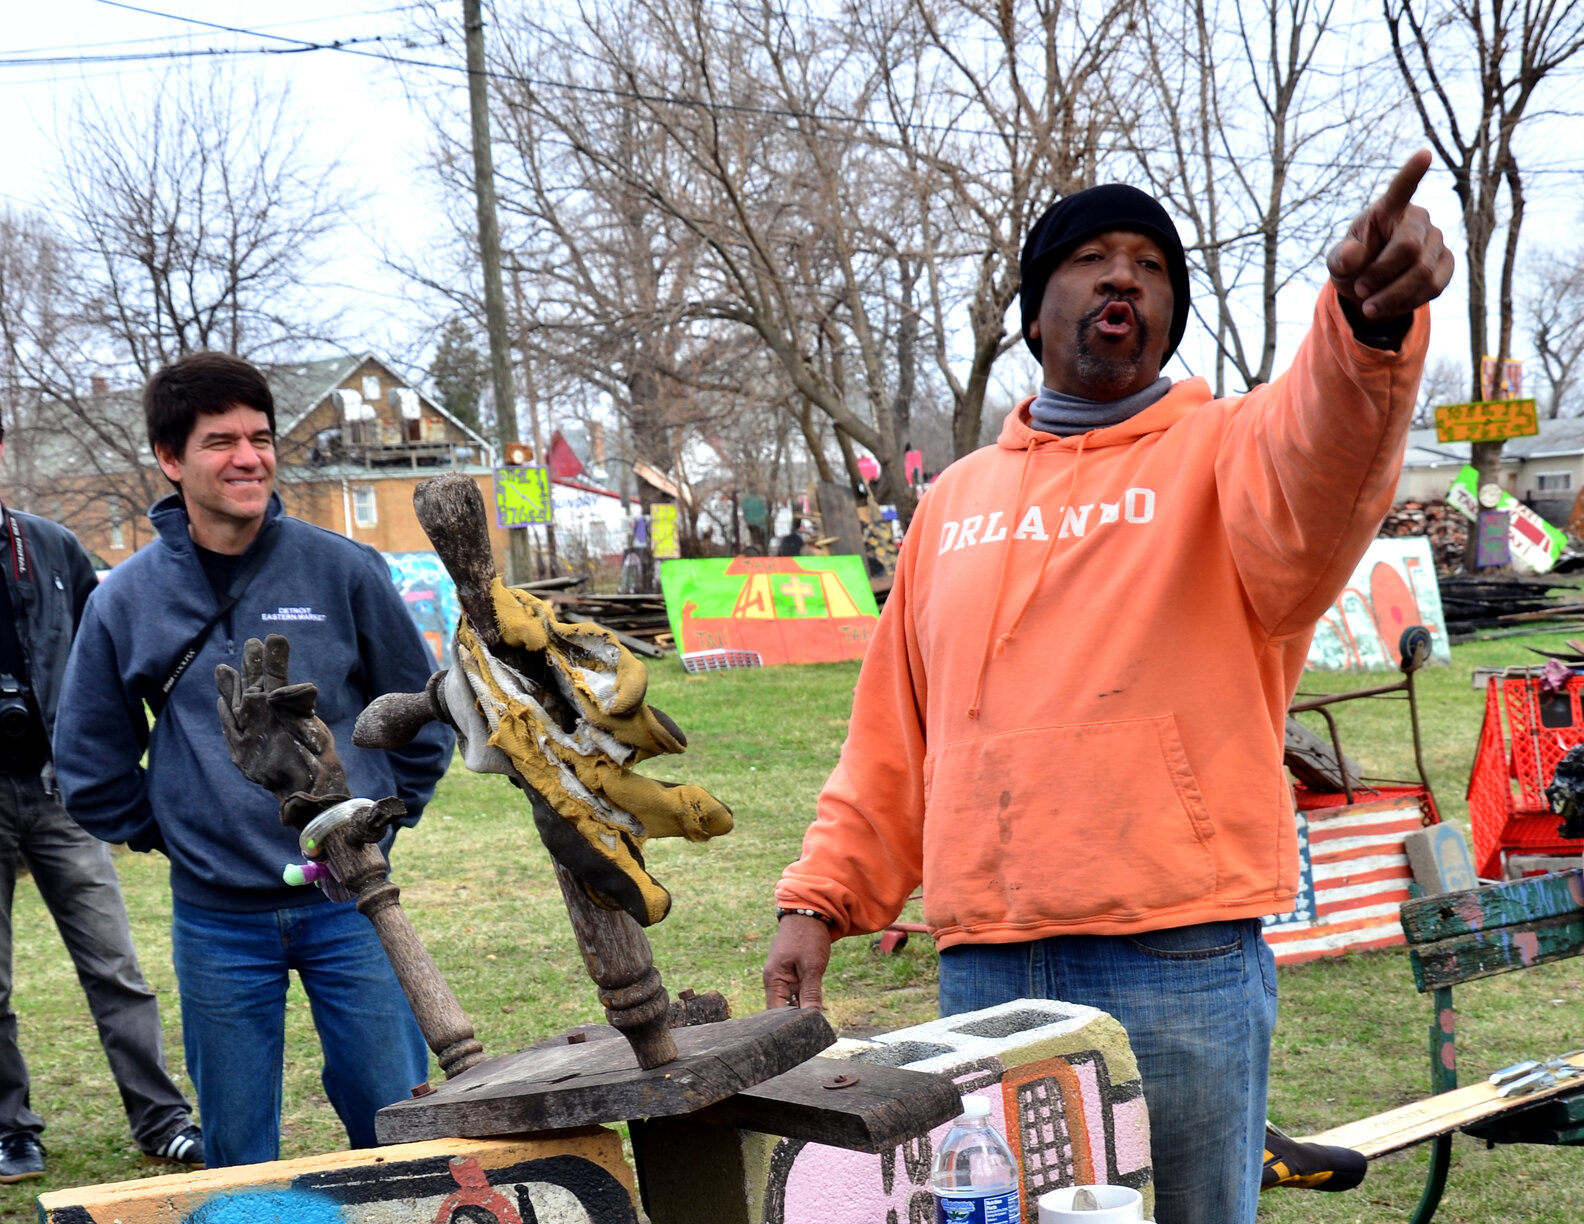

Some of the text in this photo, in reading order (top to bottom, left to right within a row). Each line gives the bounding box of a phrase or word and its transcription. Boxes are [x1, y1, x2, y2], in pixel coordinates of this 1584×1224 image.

[15, 536, 27, 573] DIGITAL
[261, 613, 327, 621] EASTERN MARKET
